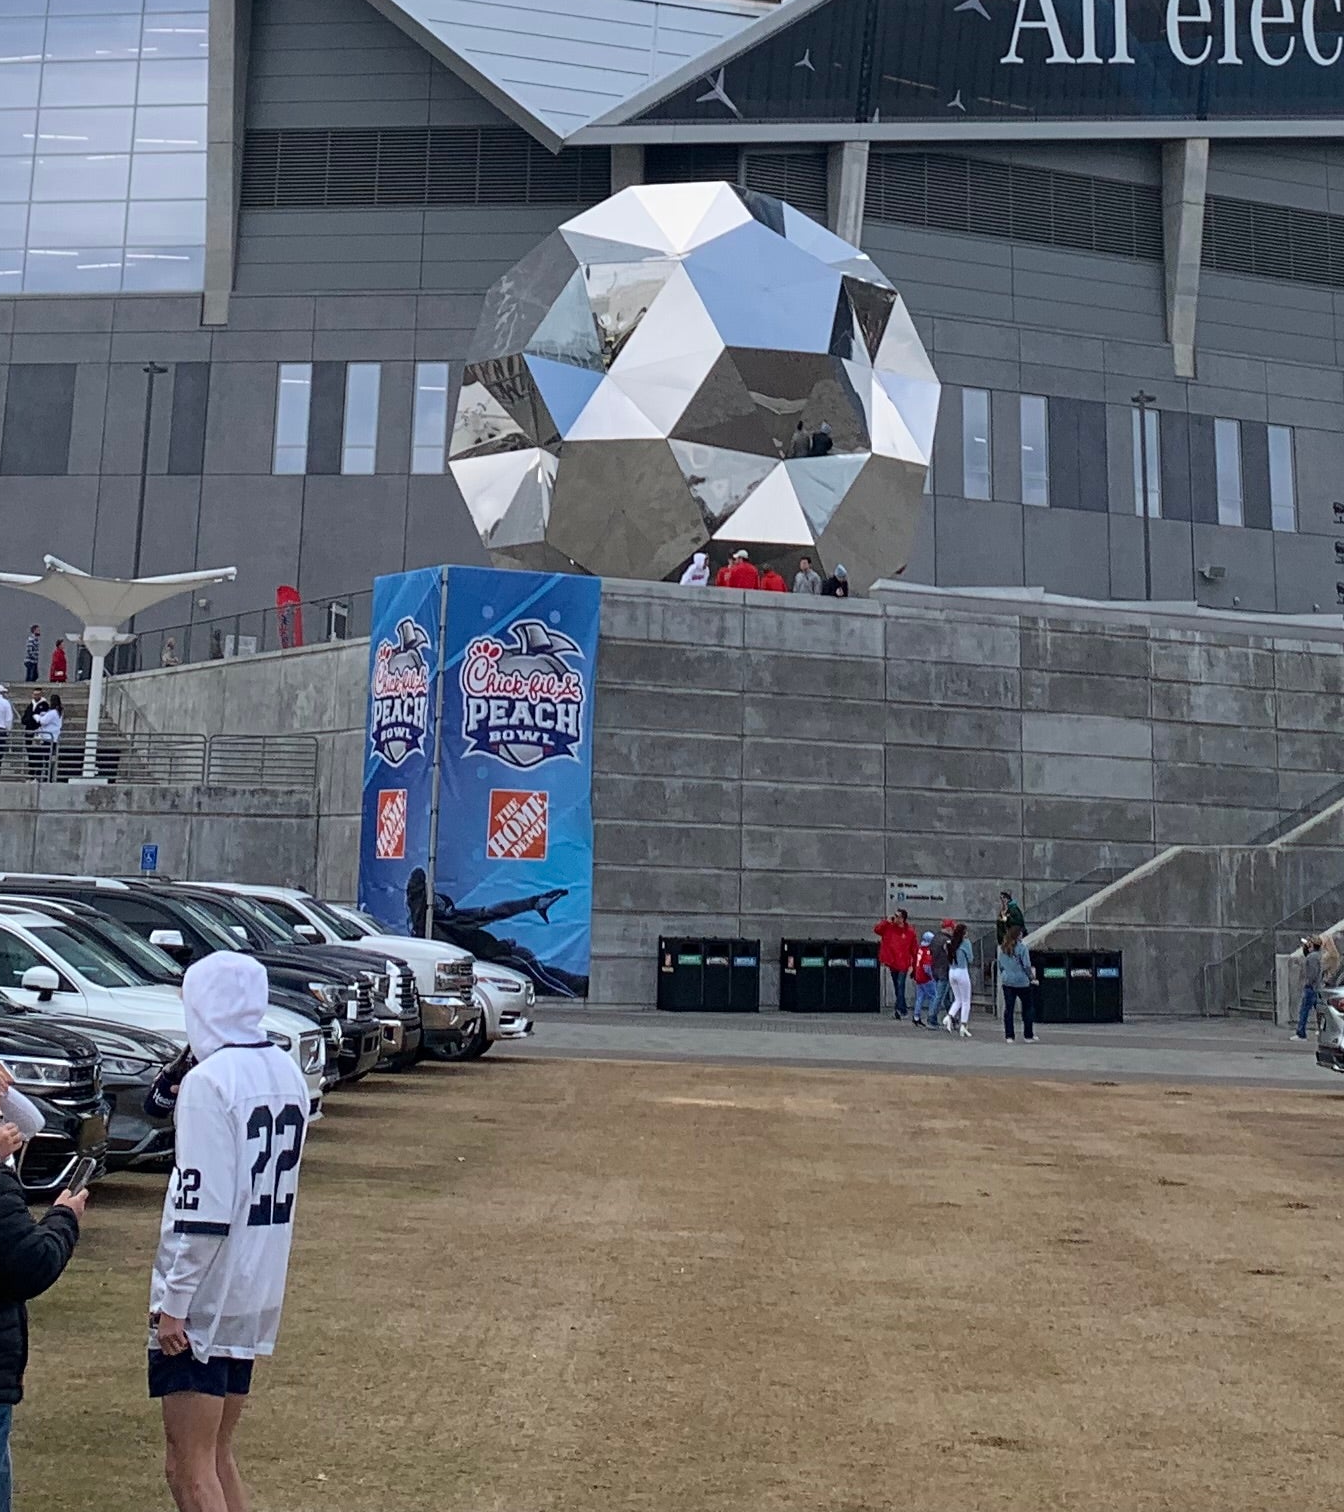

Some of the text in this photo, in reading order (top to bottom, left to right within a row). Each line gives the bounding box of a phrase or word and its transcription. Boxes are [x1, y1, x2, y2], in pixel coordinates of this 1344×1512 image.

[465, 653, 580, 701] Chick-fil-A
[373, 697, 426, 732] PEACH
[467, 698, 578, 737] PEACH
[380, 727, 412, 742] BOWL
[488, 730, 555, 746] BOWL
[488, 792, 548, 858] HOME
[494, 797, 521, 826] THE
[510, 816, 547, 858] DEPOT
[246, 1104, 305, 1227] 22
